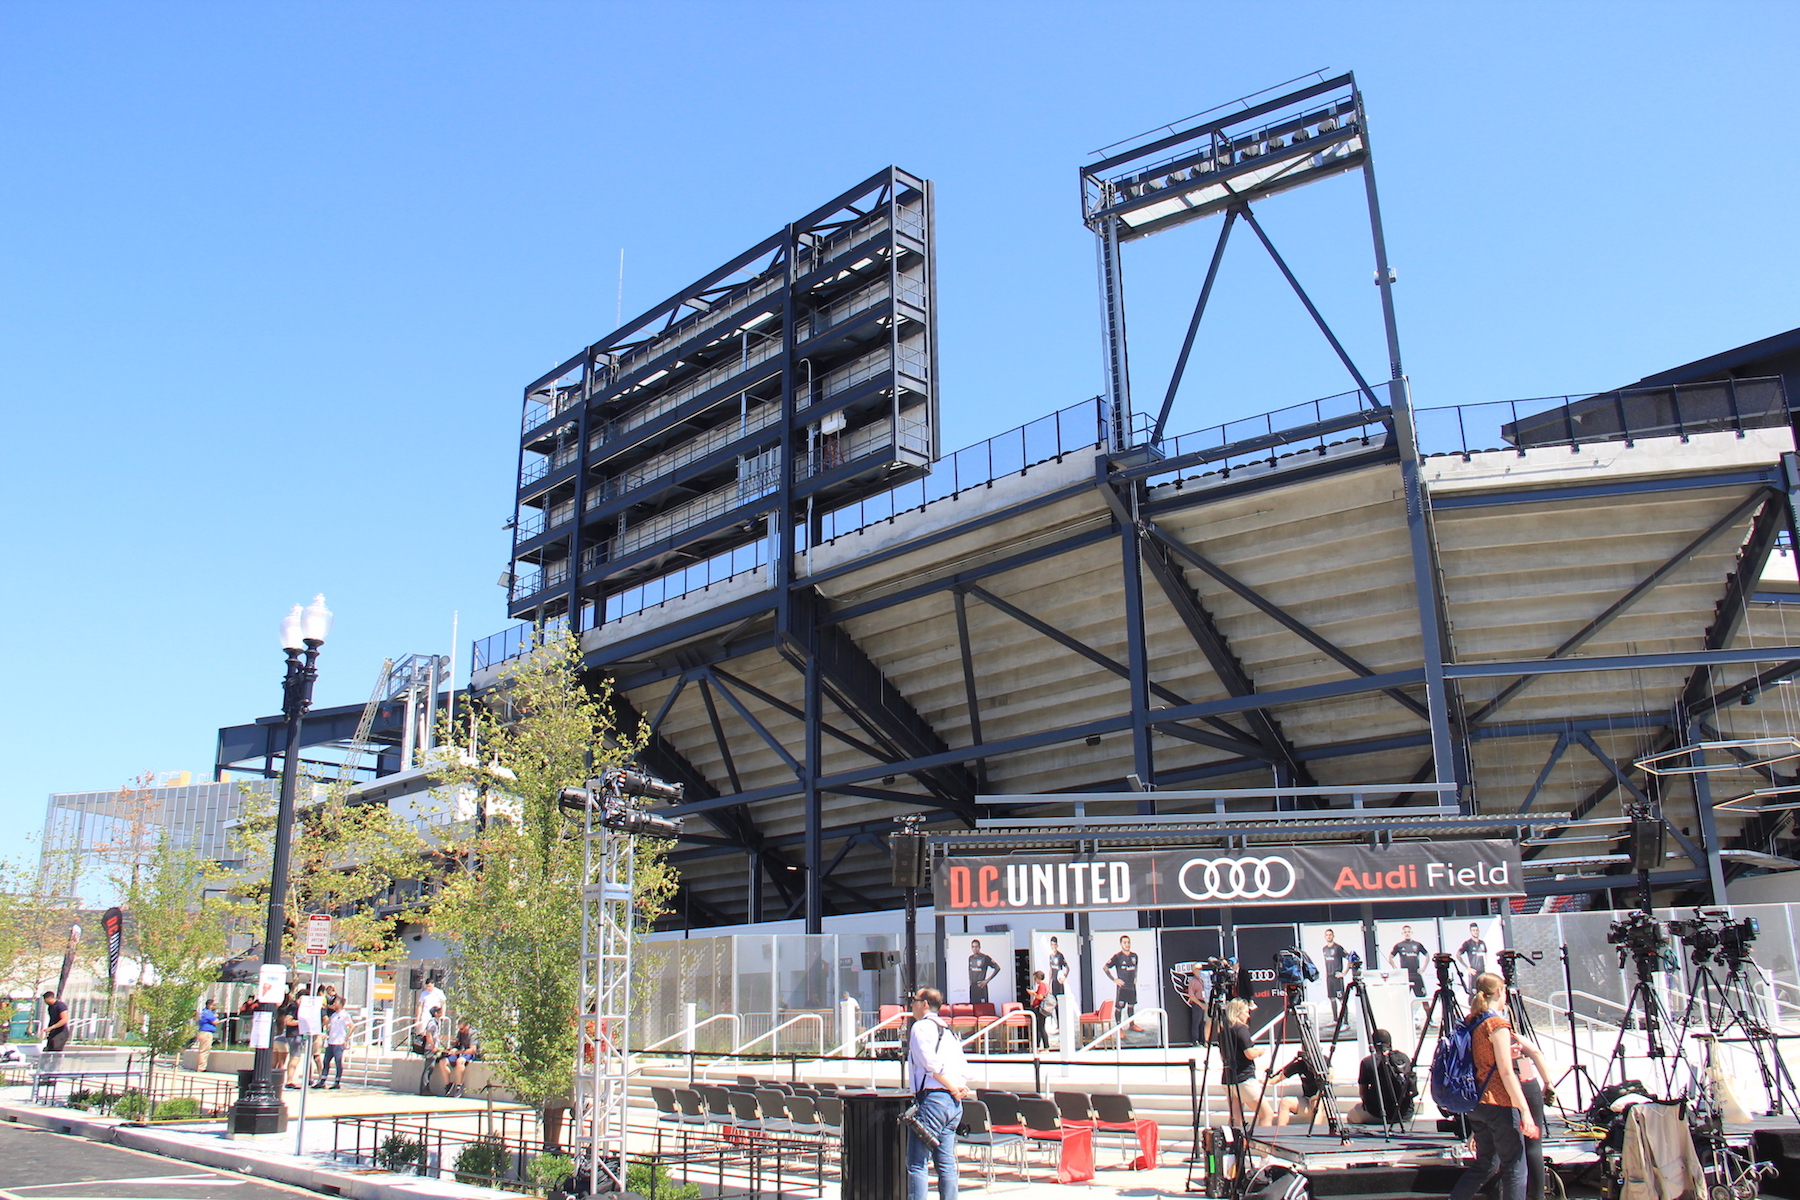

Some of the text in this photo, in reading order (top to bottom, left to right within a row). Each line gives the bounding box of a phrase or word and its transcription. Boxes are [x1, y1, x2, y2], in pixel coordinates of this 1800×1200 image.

[1333, 860, 1510, 891] Audi Field
[1254, 990, 1270, 998] udi
